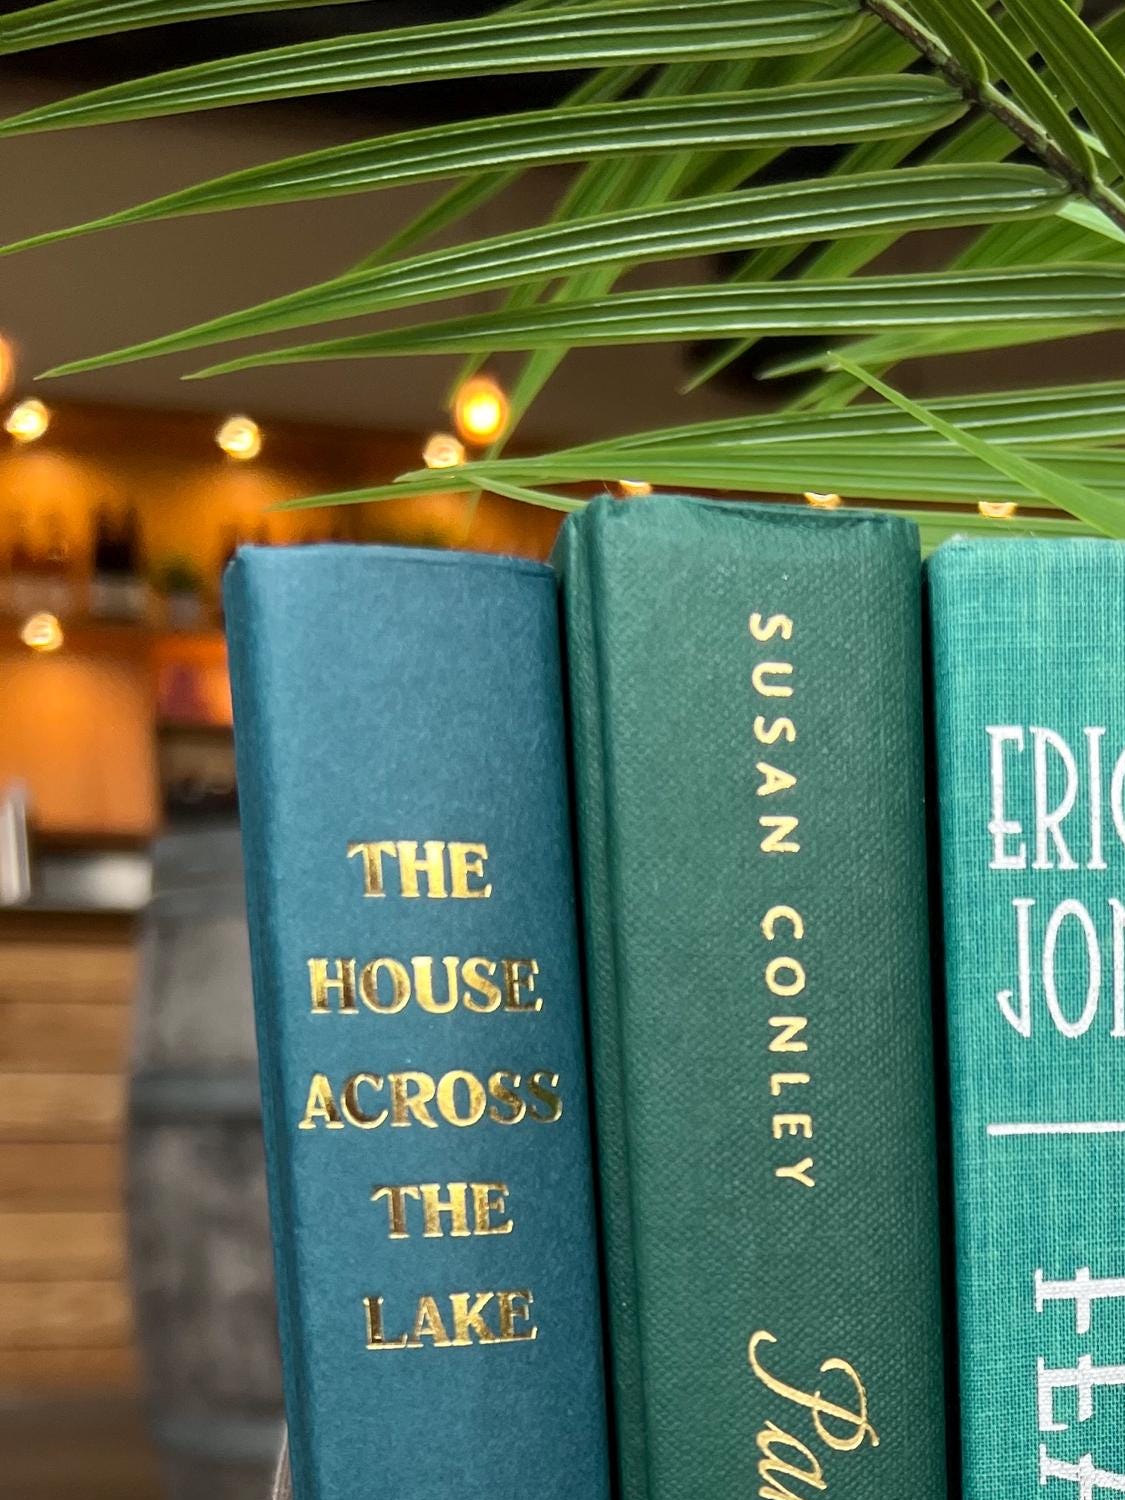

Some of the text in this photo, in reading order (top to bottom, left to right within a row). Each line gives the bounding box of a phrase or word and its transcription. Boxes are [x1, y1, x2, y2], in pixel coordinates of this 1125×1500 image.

[346, 839, 492, 898] THE
[748, 612, 816, 1189] SUSAN CONLEY
[307, 956, 544, 1014] HOUSE
[298, 1070, 563, 1129] ACROSS
[370, 1182, 514, 1239] THE
[362, 1288, 538, 1350] LAKE
